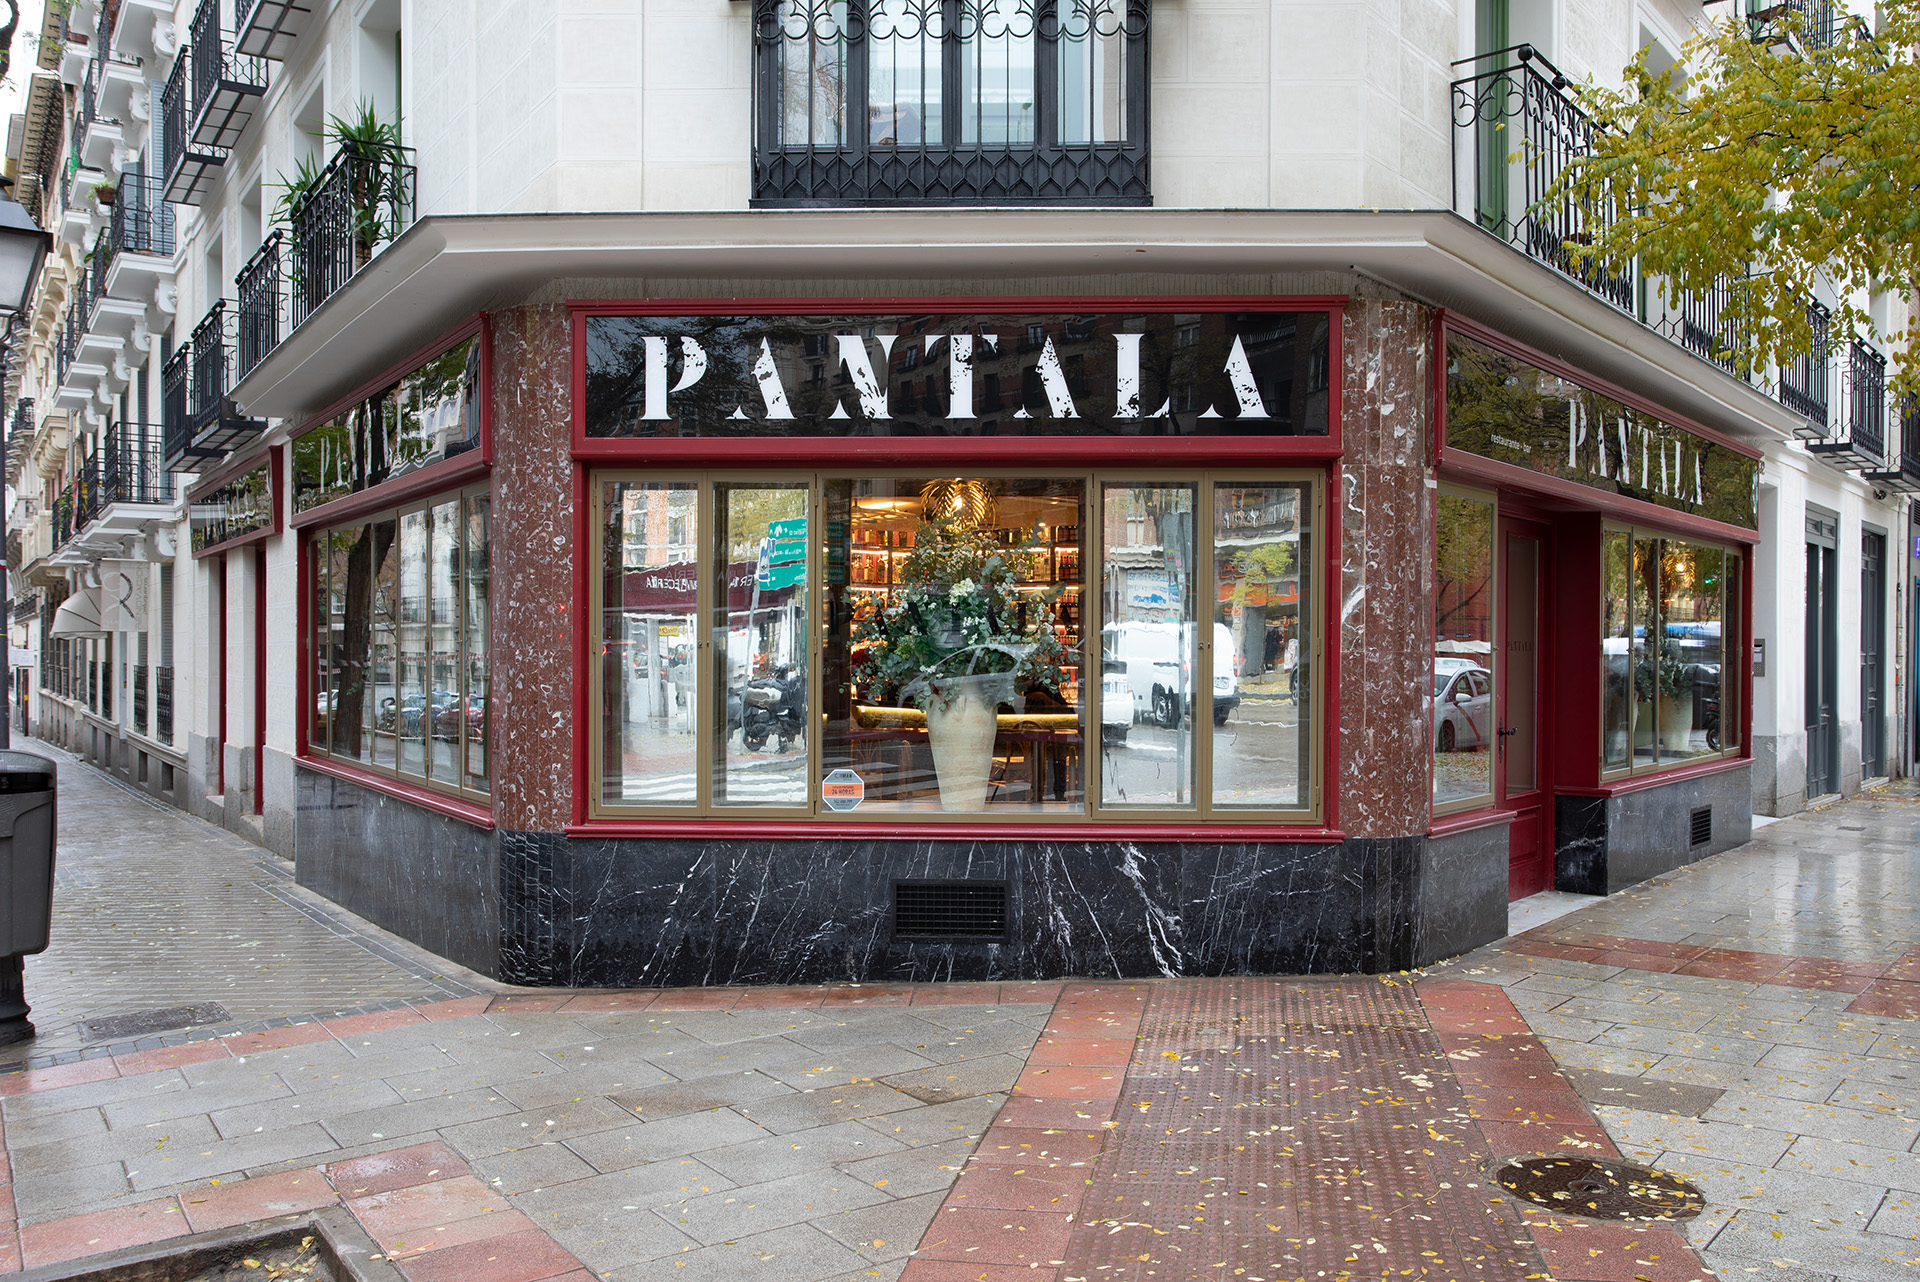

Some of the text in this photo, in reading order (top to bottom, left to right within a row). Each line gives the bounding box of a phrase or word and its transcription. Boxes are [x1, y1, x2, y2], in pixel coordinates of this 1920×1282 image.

[640, 333, 1273, 420] PANTALA
[1491, 434, 1532, 454] restaurante bar
[1568, 399, 1703, 506] PANTALA
